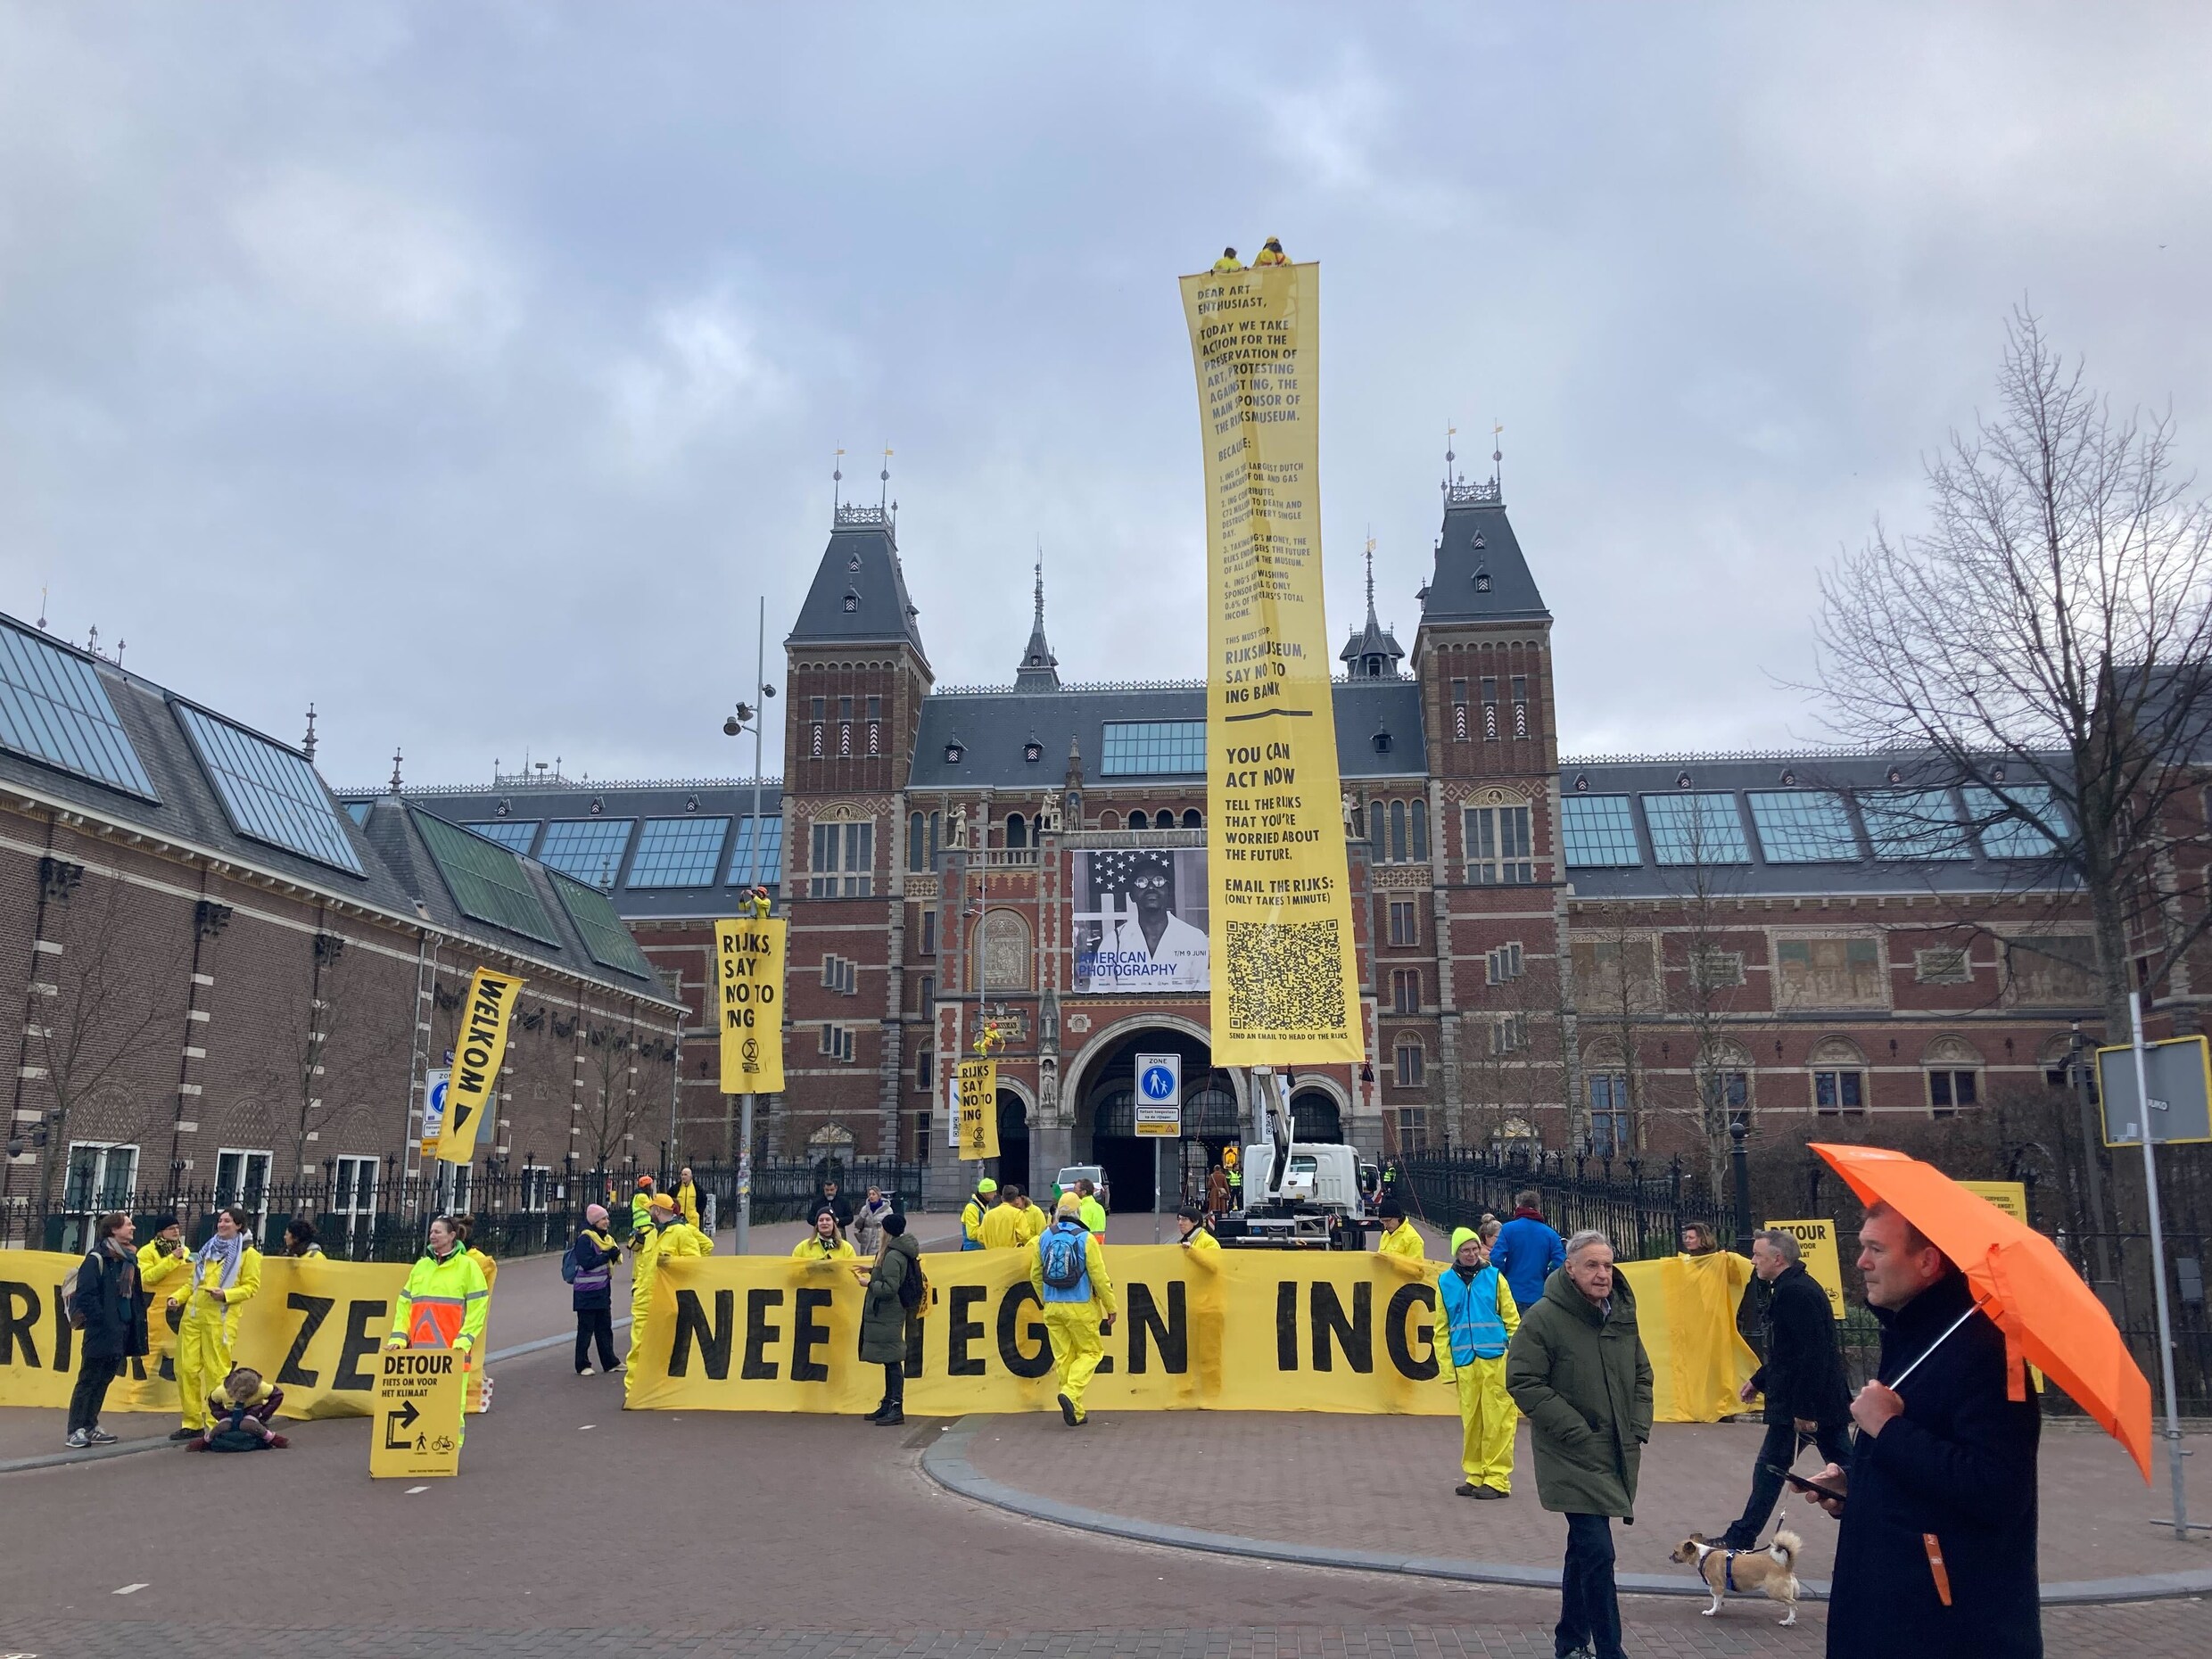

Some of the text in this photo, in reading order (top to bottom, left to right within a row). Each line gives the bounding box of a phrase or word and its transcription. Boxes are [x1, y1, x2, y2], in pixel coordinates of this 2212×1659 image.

[1198, 285, 1250, 301] DEAR ART
[1198, 297, 1267, 315] ENTHUSIAST,
[1201, 320, 1289, 341] TODAY WE TAKE
[1202, 335, 1287, 356] ACTION FOR THE
[1205, 349, 1298, 372] PRESERVATION OF
[1208, 364, 1294, 388] ART, PROTESTING
[1210, 379, 1298, 403] AGAINST ING, THE
[1212, 394, 1300, 419] MAIN SPONSOR OF
[1215, 410, 1300, 435] THE RIJKSMUSEUM.
[1218, 438, 1250, 462] BECAUSE:
[1226, 471, 1234, 480] ING
[1280, 463, 1303, 471] DUTCH
[1267, 475, 1280, 483] AND
[1283, 475, 1298, 483] GAS
[1228, 496, 1237, 505] ING
[1234, 499, 1250, 514] MILLION
[1263, 499, 1283, 508] DEATH
[1286, 500, 1301, 509] AND
[1256, 509, 1276, 517] EVERY
[1278, 511, 1301, 520] SINGLE
[1223, 530, 1236, 540] DAY.
[1267, 534, 1292, 546] MONEY,
[1293, 537, 1307, 545] THE
[1224, 553, 1239, 565] RIJKS
[1272, 546, 1283, 554] THE
[1285, 547, 1310, 557] FUTURE
[1225, 566, 1232, 574] OF
[1234, 563, 1243, 573] ALL
[1262, 556, 1272, 564] THE
[1275, 557, 1304, 567] MUSEUM.
[1234, 574, 1250, 587] ING'S
[1225, 585, 1251, 599] SPONSOR
[1273, 582, 1291, 590] ONLY
[1242, 598, 1250, 606] OF
[1283, 593, 1304, 603] TOTAL
[1225, 607, 1250, 621] INCOME.
[1226, 637, 1240, 645] THIS
[1242, 631, 1257, 641] MUST
[1226, 641, 1307, 664] RIJKSMUSEUM,
[1226, 662, 1285, 684] SAY NO TO
[1226, 681, 1281, 704] ING BANK
[1226, 742, 1290, 764] YOU CAN
[1226, 767, 1295, 788] ACT NOW
[1226, 796, 1301, 811] TELL THE RIJKS
[1226, 813, 1296, 828] THAT YOU'RE
[1226, 830, 1319, 844] WORRIED ABOUT
[1226, 849, 1246, 861] THE
[1226, 876, 1333, 893] EMAIL THE RIJKS:
[1225, 893, 1330, 906] (ONLY TAKES 1 MINUTE)
[723, 933, 772, 956] RIJKS,
[1079, 951, 1146, 963] AMERICAN
[725, 958, 756, 978] SAY
[1079, 963, 1177, 977] PHOTOGRAPHY
[726, 983, 774, 1003] NO TO
[458, 978, 508, 1094] WELKOM
[962, 1065, 989, 1079] RIJKS
[963, 1080, 983, 1094] SAY
[963, 1094, 992, 1107] NO TO
[964, 1109, 981, 1122] ING
[667, 1287, 833, 1382] NEE
[1275, 1281, 1440, 1382] ING
[384, 1356, 453, 1374] DETOUR
[383, 1378, 400, 1386] FIETS
[402, 1378, 415, 1386] OM
[382, 1389, 428, 1398] HET KLIMAAT
